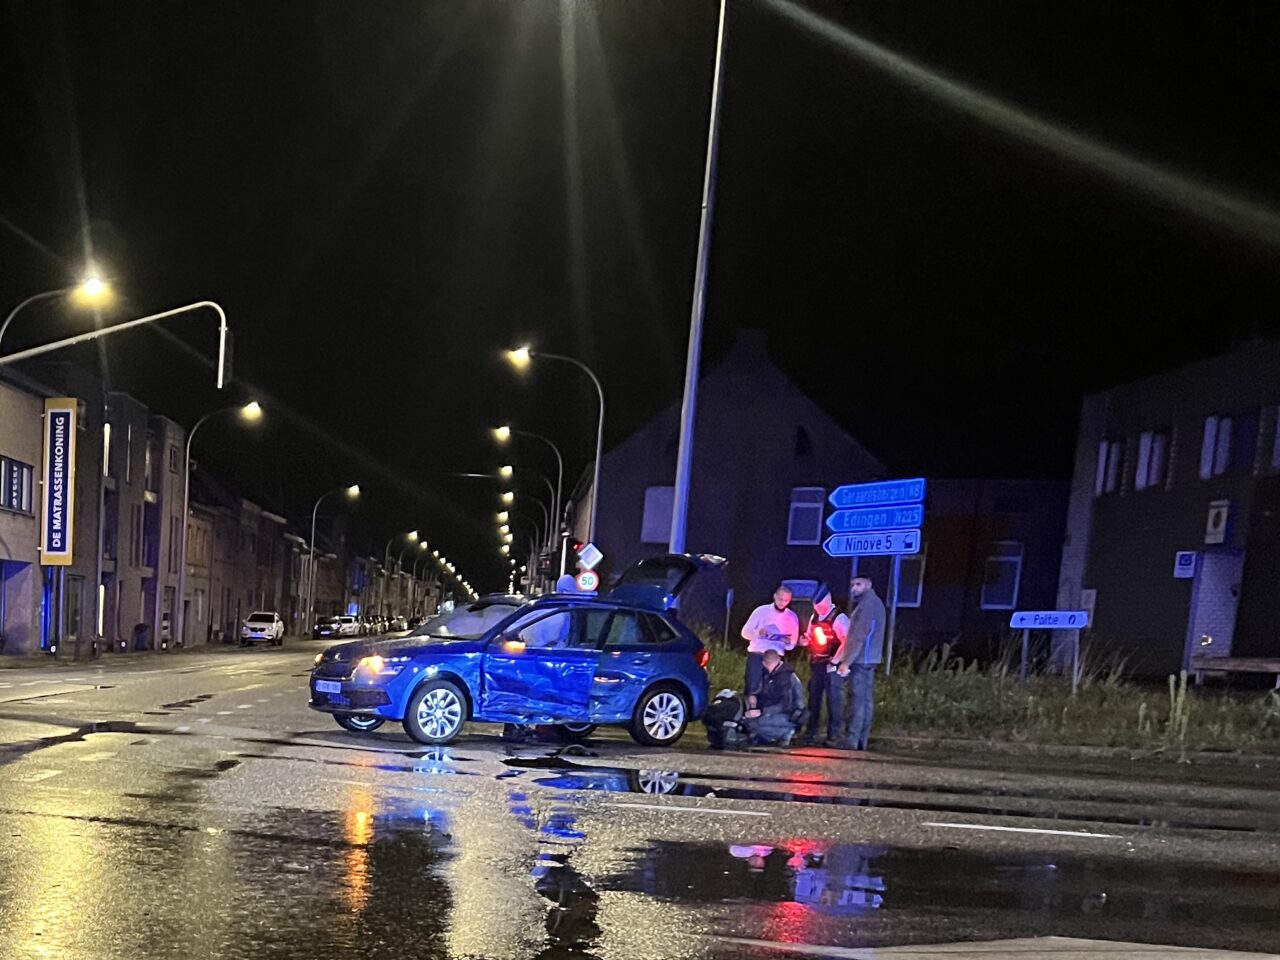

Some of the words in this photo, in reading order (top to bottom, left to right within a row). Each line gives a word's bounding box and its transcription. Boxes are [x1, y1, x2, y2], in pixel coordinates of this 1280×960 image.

[52, 417, 65, 529] MATRASSENKONING
[843, 512, 887, 528] Edingen
[52, 532, 62, 548] DE
[845, 536, 882, 552] Ninove
[885, 534, 893, 550] 5
[581, 576, 594, 586] 50
